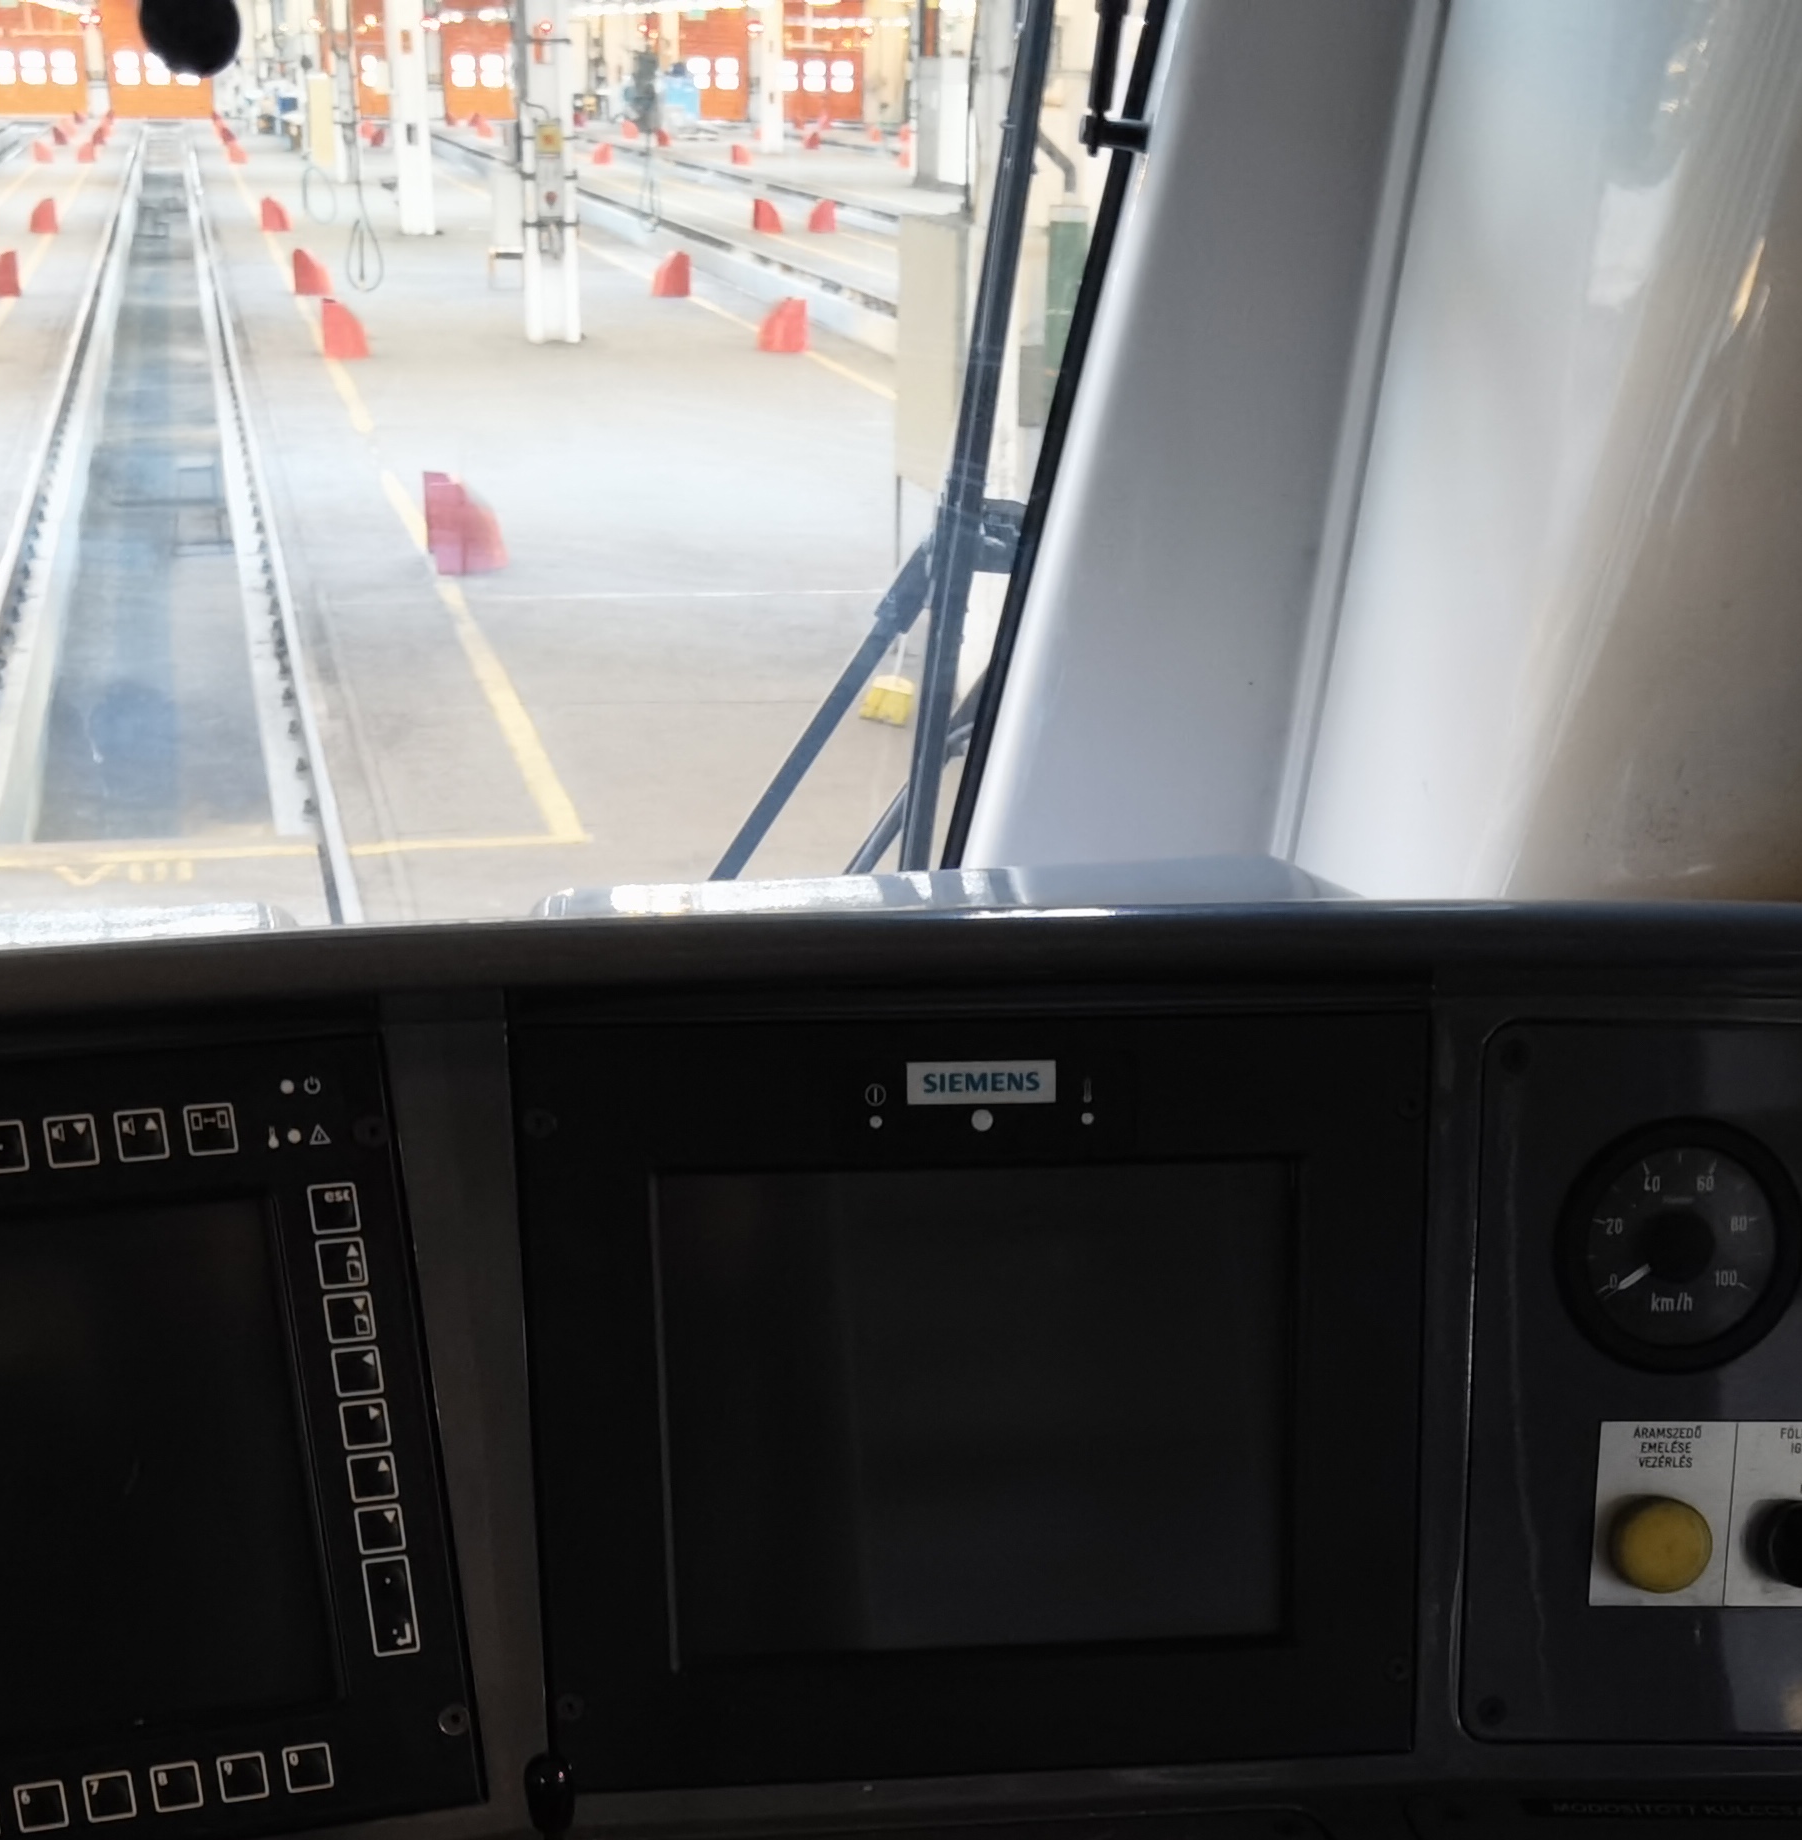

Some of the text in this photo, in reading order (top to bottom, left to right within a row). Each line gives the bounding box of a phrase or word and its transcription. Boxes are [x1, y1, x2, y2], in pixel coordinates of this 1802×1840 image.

[923, 1071, 1040, 1094] SIEMENS
[1643, 1175, 1661, 1193] 40
[1696, 1175, 1714, 1192] 60
[324, 1189, 352, 1204] esc
[1605, 1217, 1623, 1235] 20
[1730, 1215, 1748, 1233] 80
[1714, 1270, 1738, 1287] 100
[1651, 1292, 1694, 1312] km/h
[1633, 1425, 1702, 1440] ÁRAMSZEDŐ
[1640, 1441, 1692, 1454] EMELÉSE
[1638, 1456, 1693, 1469] VEZÉRLÉS
[288, 1751, 300, 1767] 0
[223, 1761, 234, 1776] 9
[157, 1771, 169, 1787] 8
[88, 1780, 100, 1795] 7
[20, 1790, 32, 1805] 6
